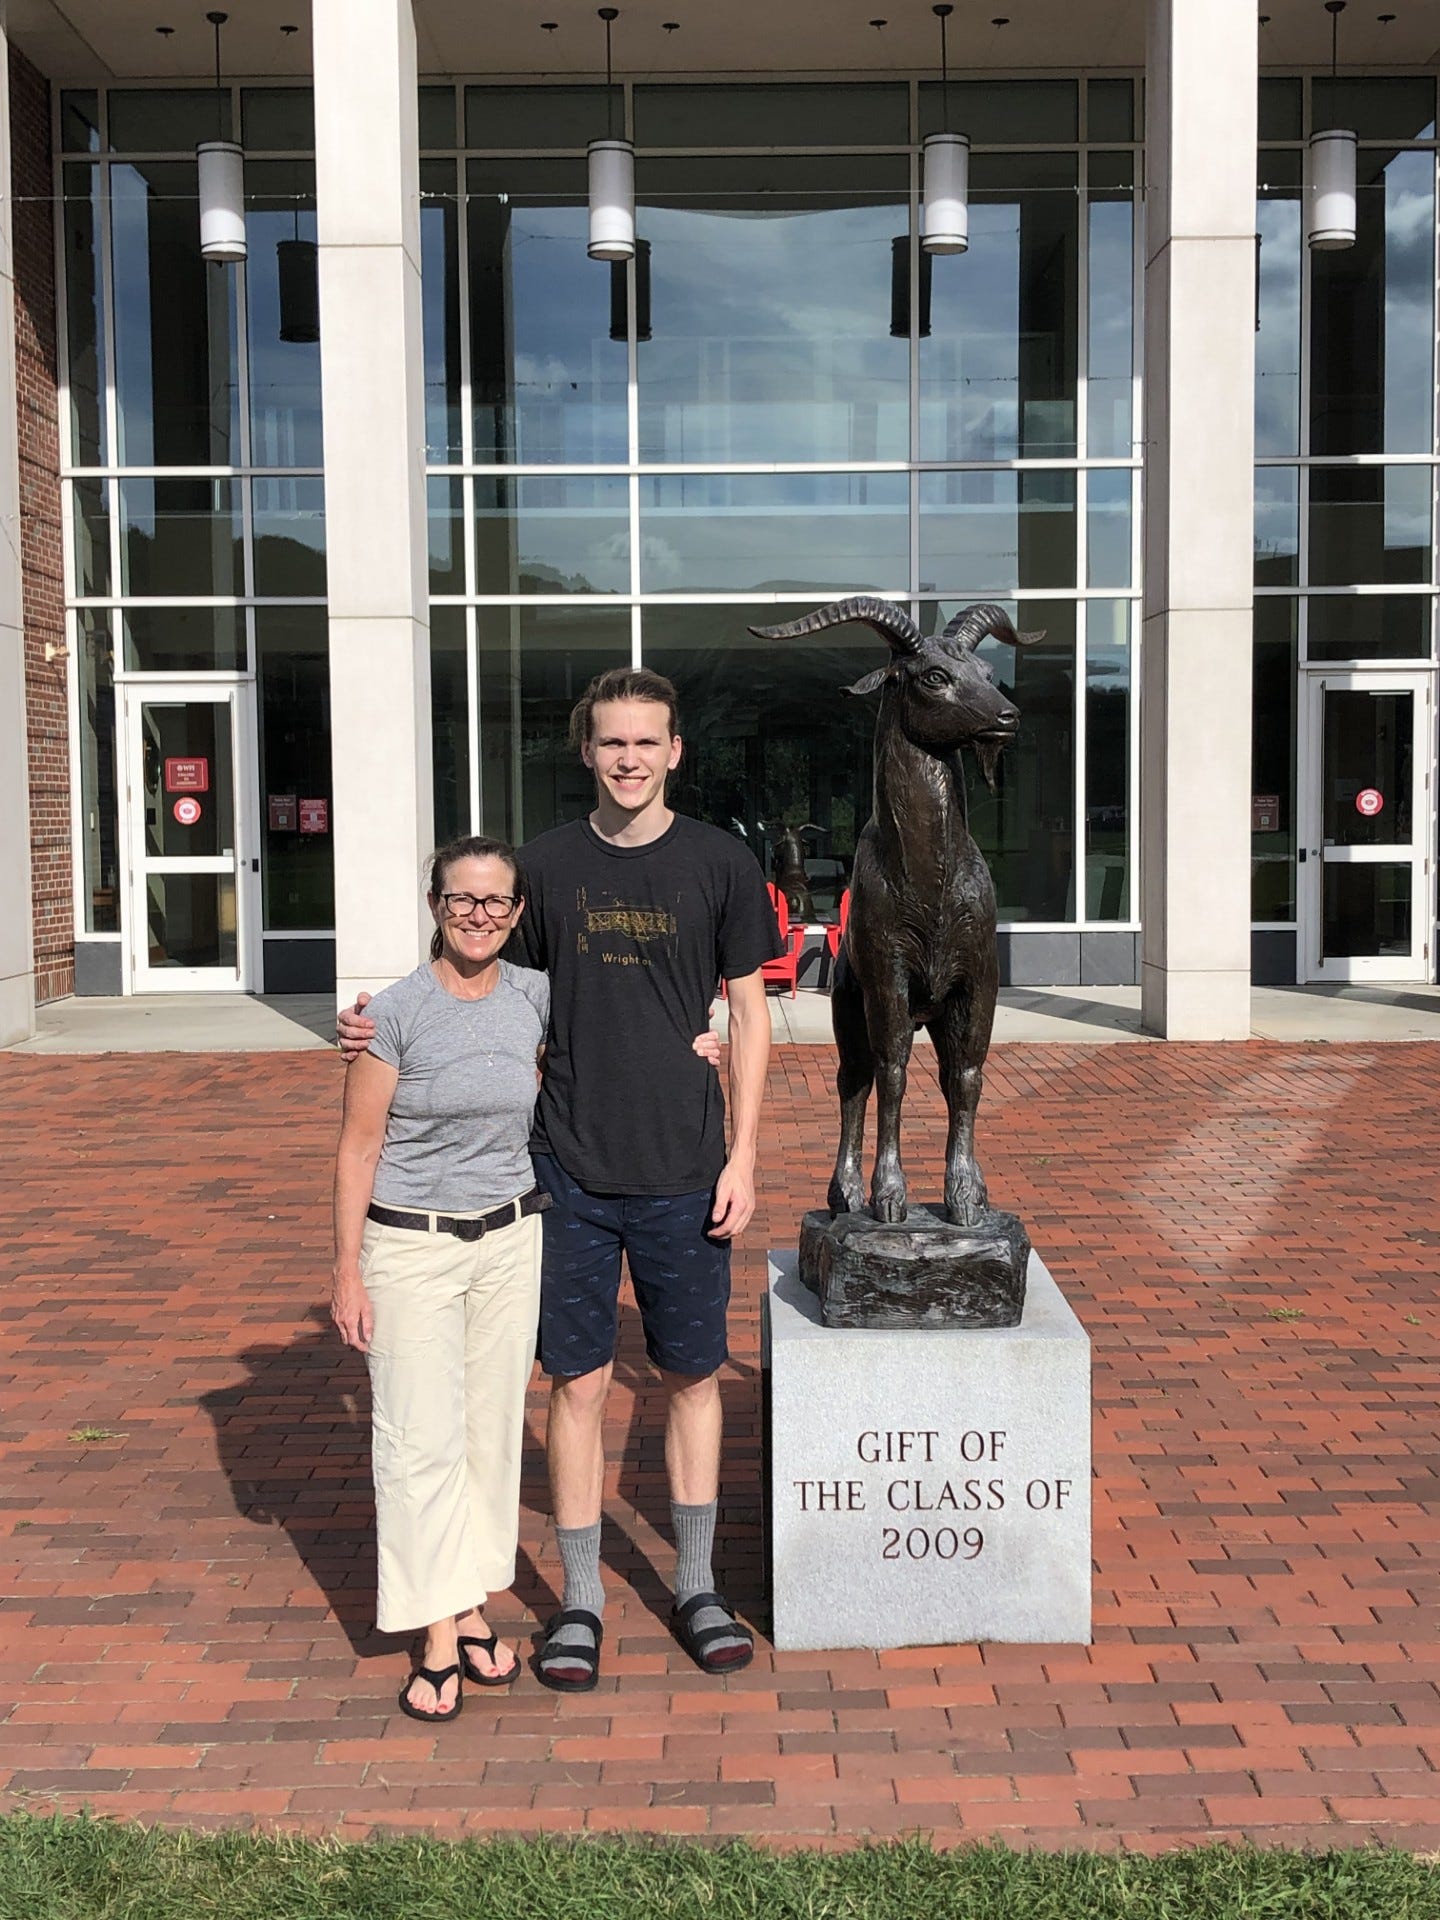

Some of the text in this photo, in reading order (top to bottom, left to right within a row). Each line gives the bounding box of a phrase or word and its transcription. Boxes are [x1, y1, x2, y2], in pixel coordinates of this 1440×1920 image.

[602, 953, 639, 966] Wright
[857, 1430, 1007, 1463] GIFT OF
[793, 1479, 1073, 1511] THE CLASS OF
[882, 1527, 984, 1560] 2009
